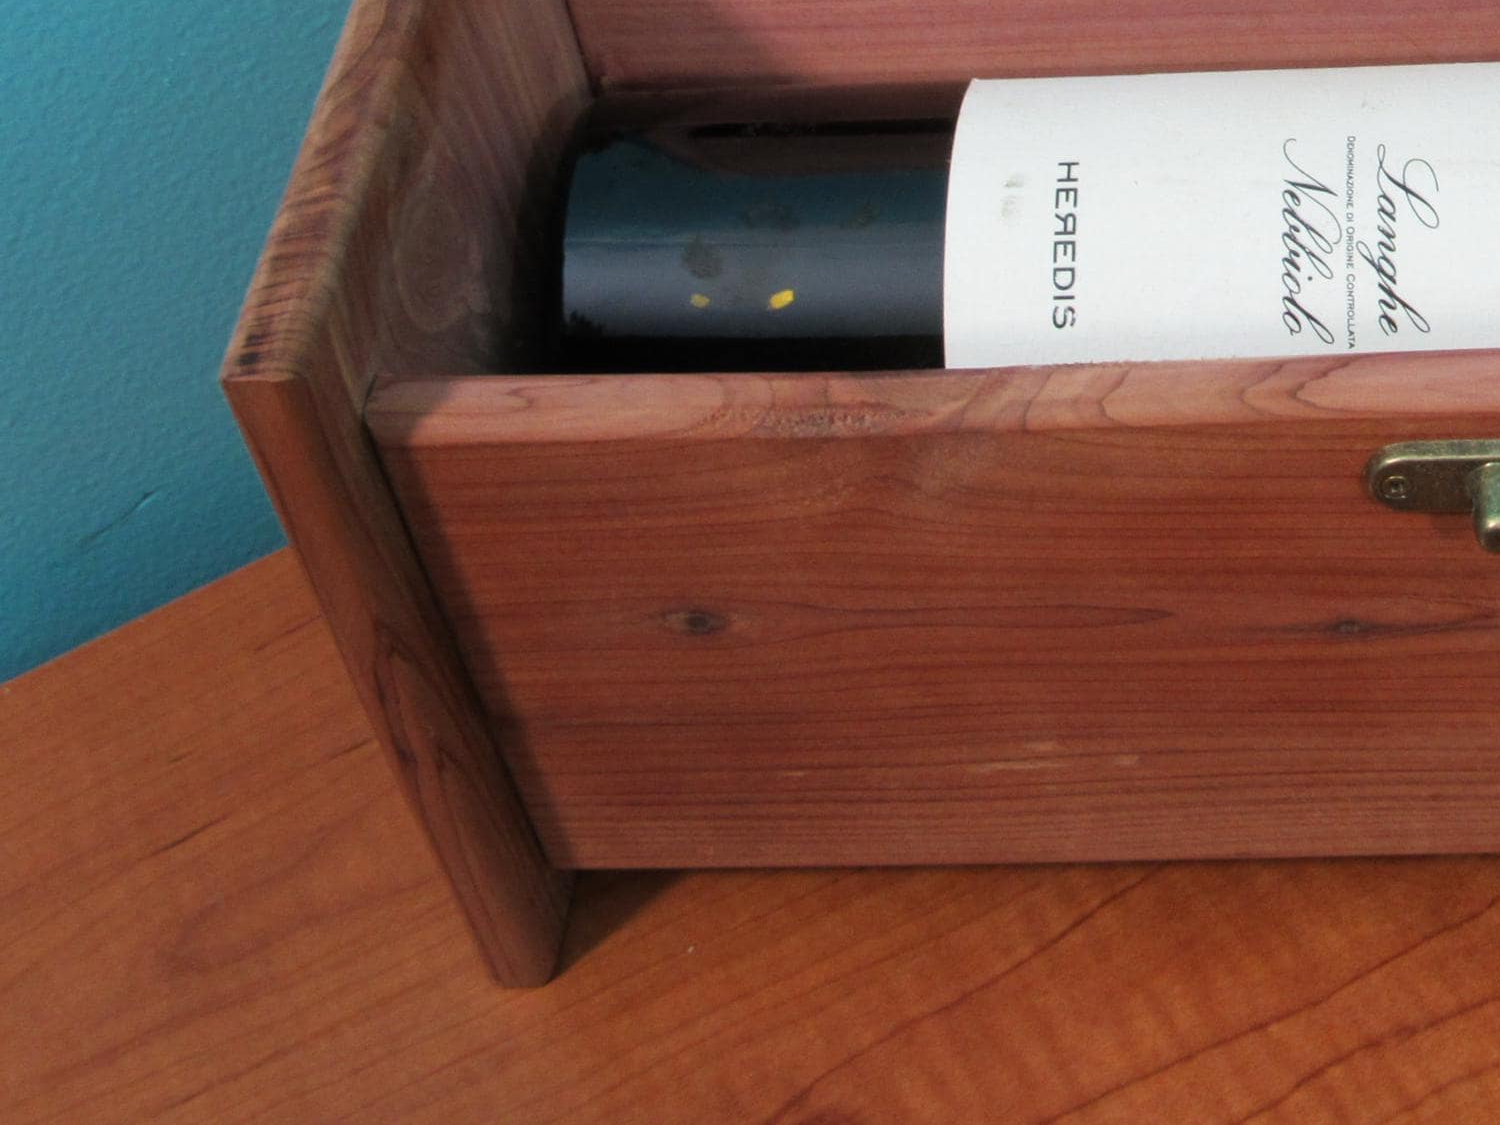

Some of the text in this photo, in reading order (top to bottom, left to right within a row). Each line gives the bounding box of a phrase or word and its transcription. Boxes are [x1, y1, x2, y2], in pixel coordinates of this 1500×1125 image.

[1052, 161, 1080, 329] HEREDIS
[1281, 138, 1343, 345] Nebbiolo
[1345, 226, 1356, 269] ORIGINE
[1345, 273, 1356, 350] CONTROLLATA
[1355, 143, 1440, 337] Langhe
